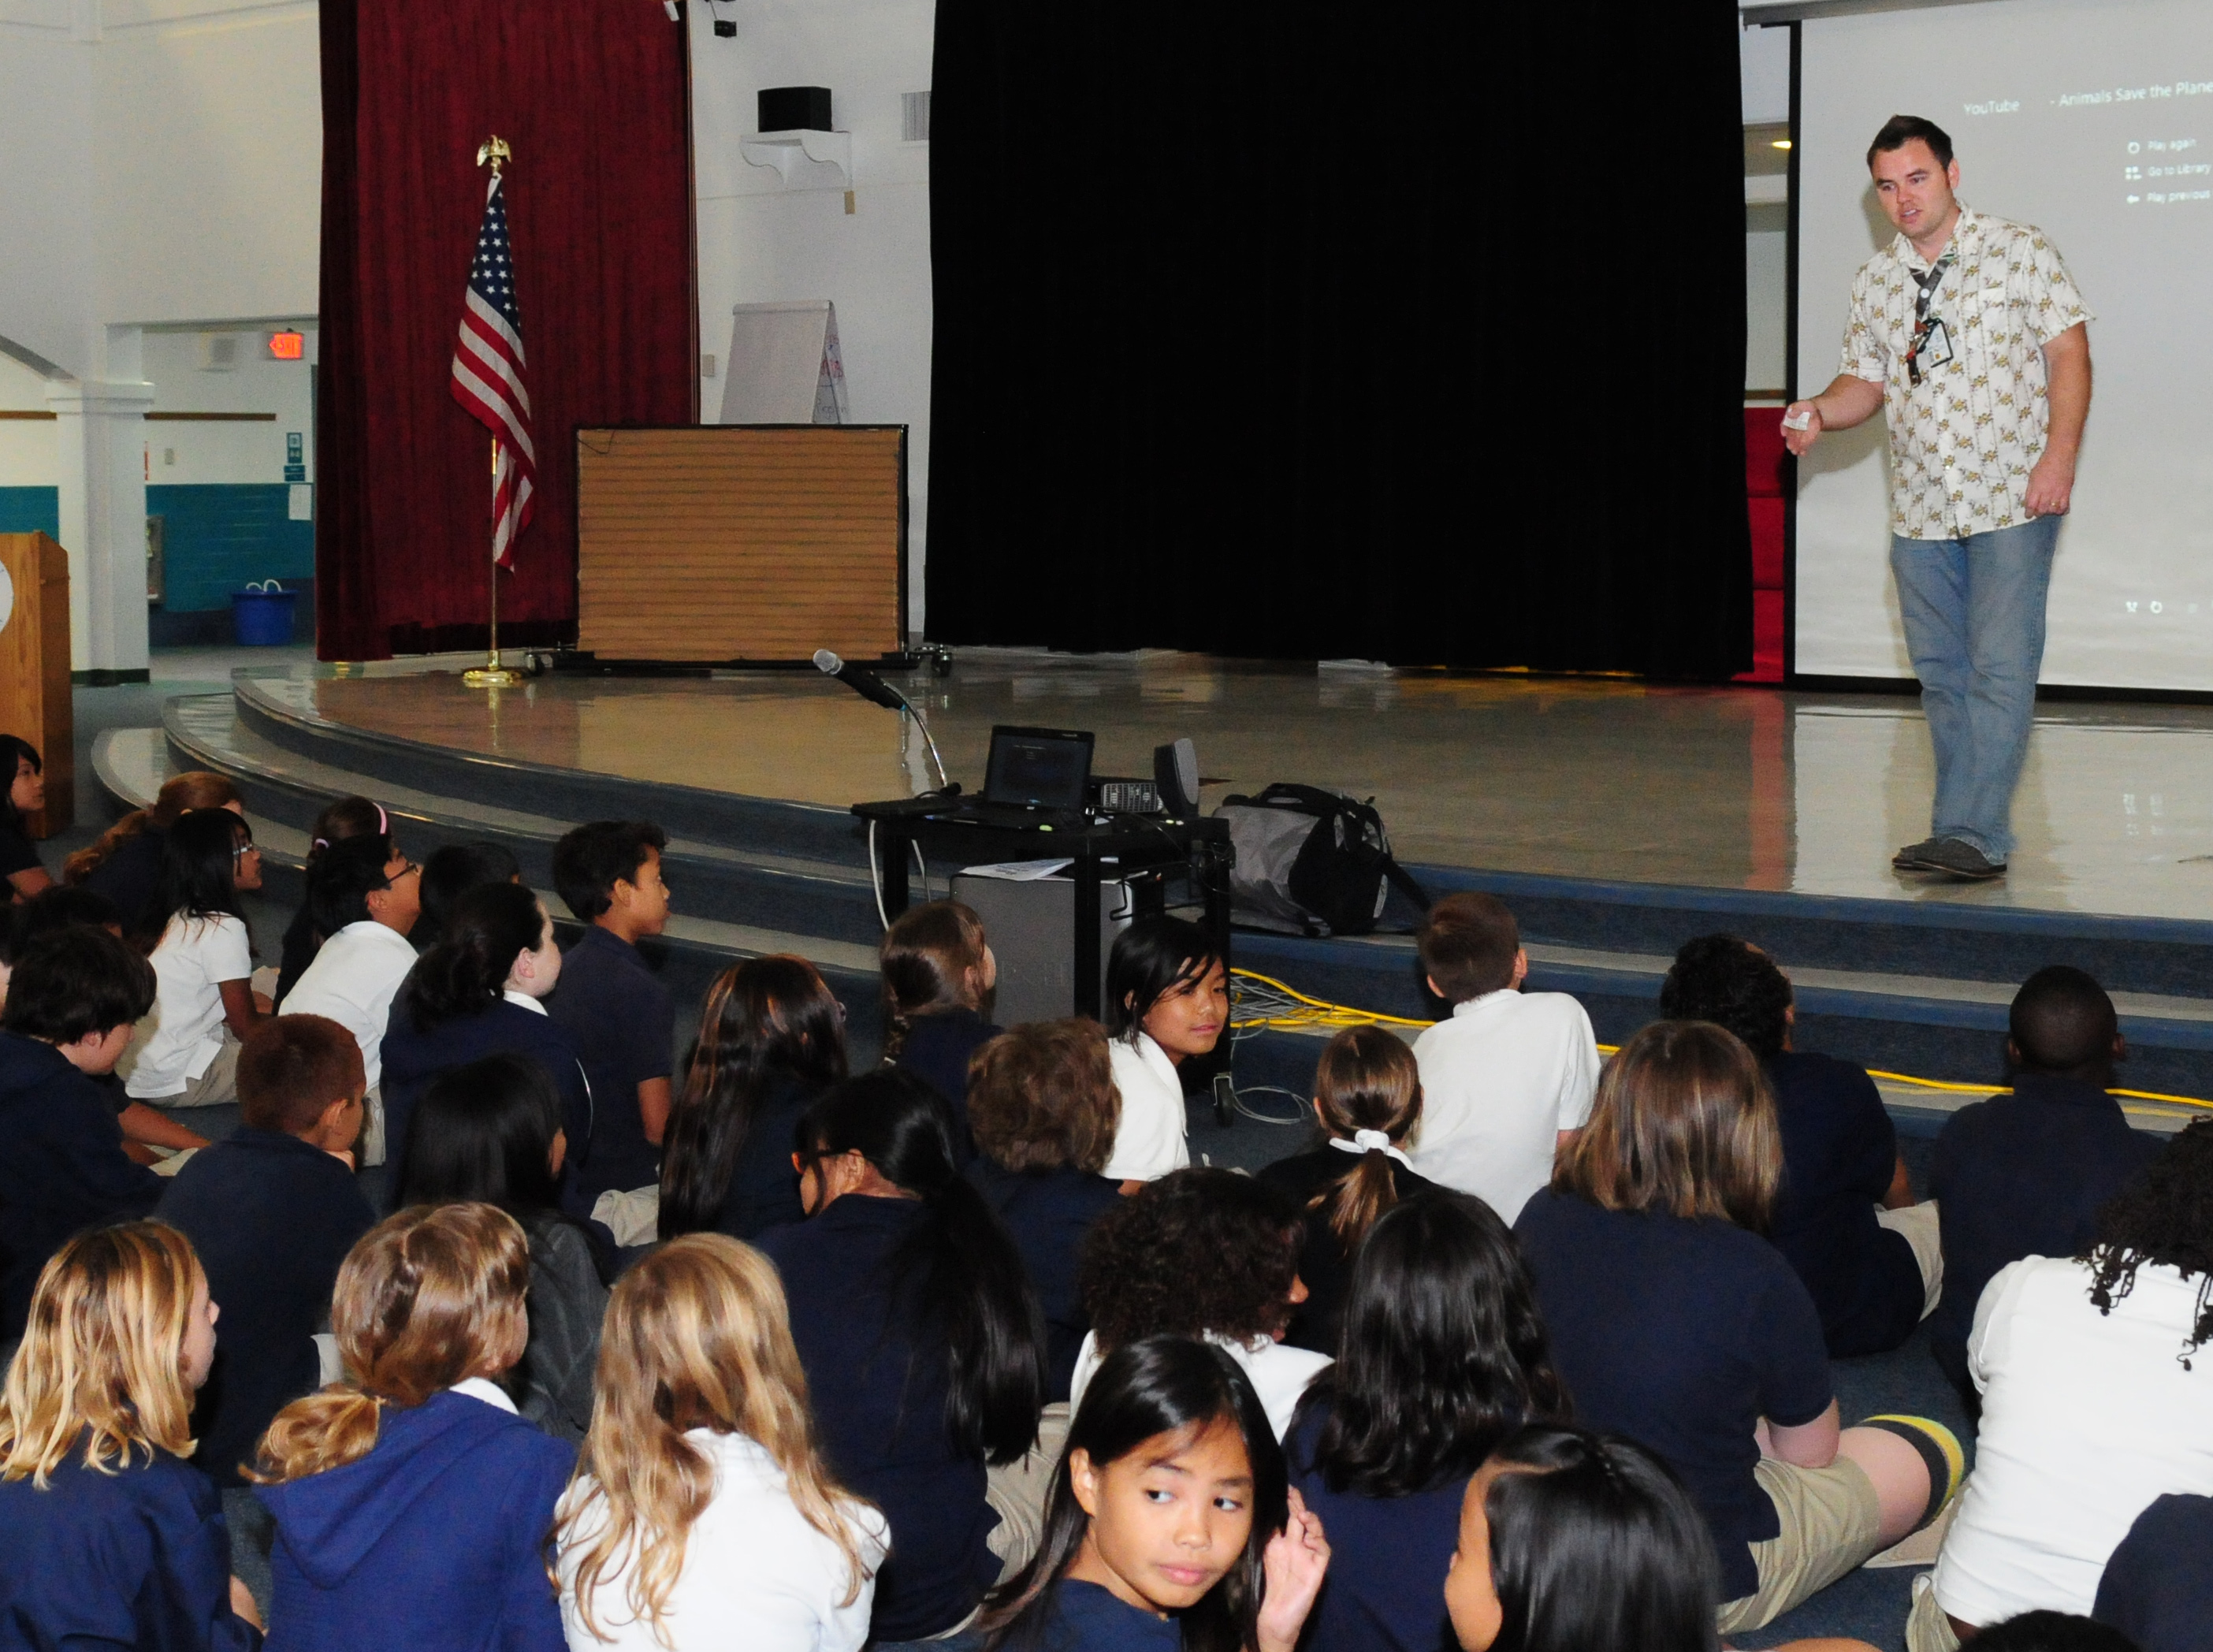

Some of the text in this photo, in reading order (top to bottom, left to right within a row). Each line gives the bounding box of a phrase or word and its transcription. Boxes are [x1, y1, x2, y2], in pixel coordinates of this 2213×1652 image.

[1963, 99, 2020, 115] YouTube
[2059, 90, 2113, 106] Animals
[2115, 87, 2147, 102] Save
[2149, 84, 2172, 98] the
[2148, 166, 2163, 177] Go
[2177, 164, 2211, 176] Library
